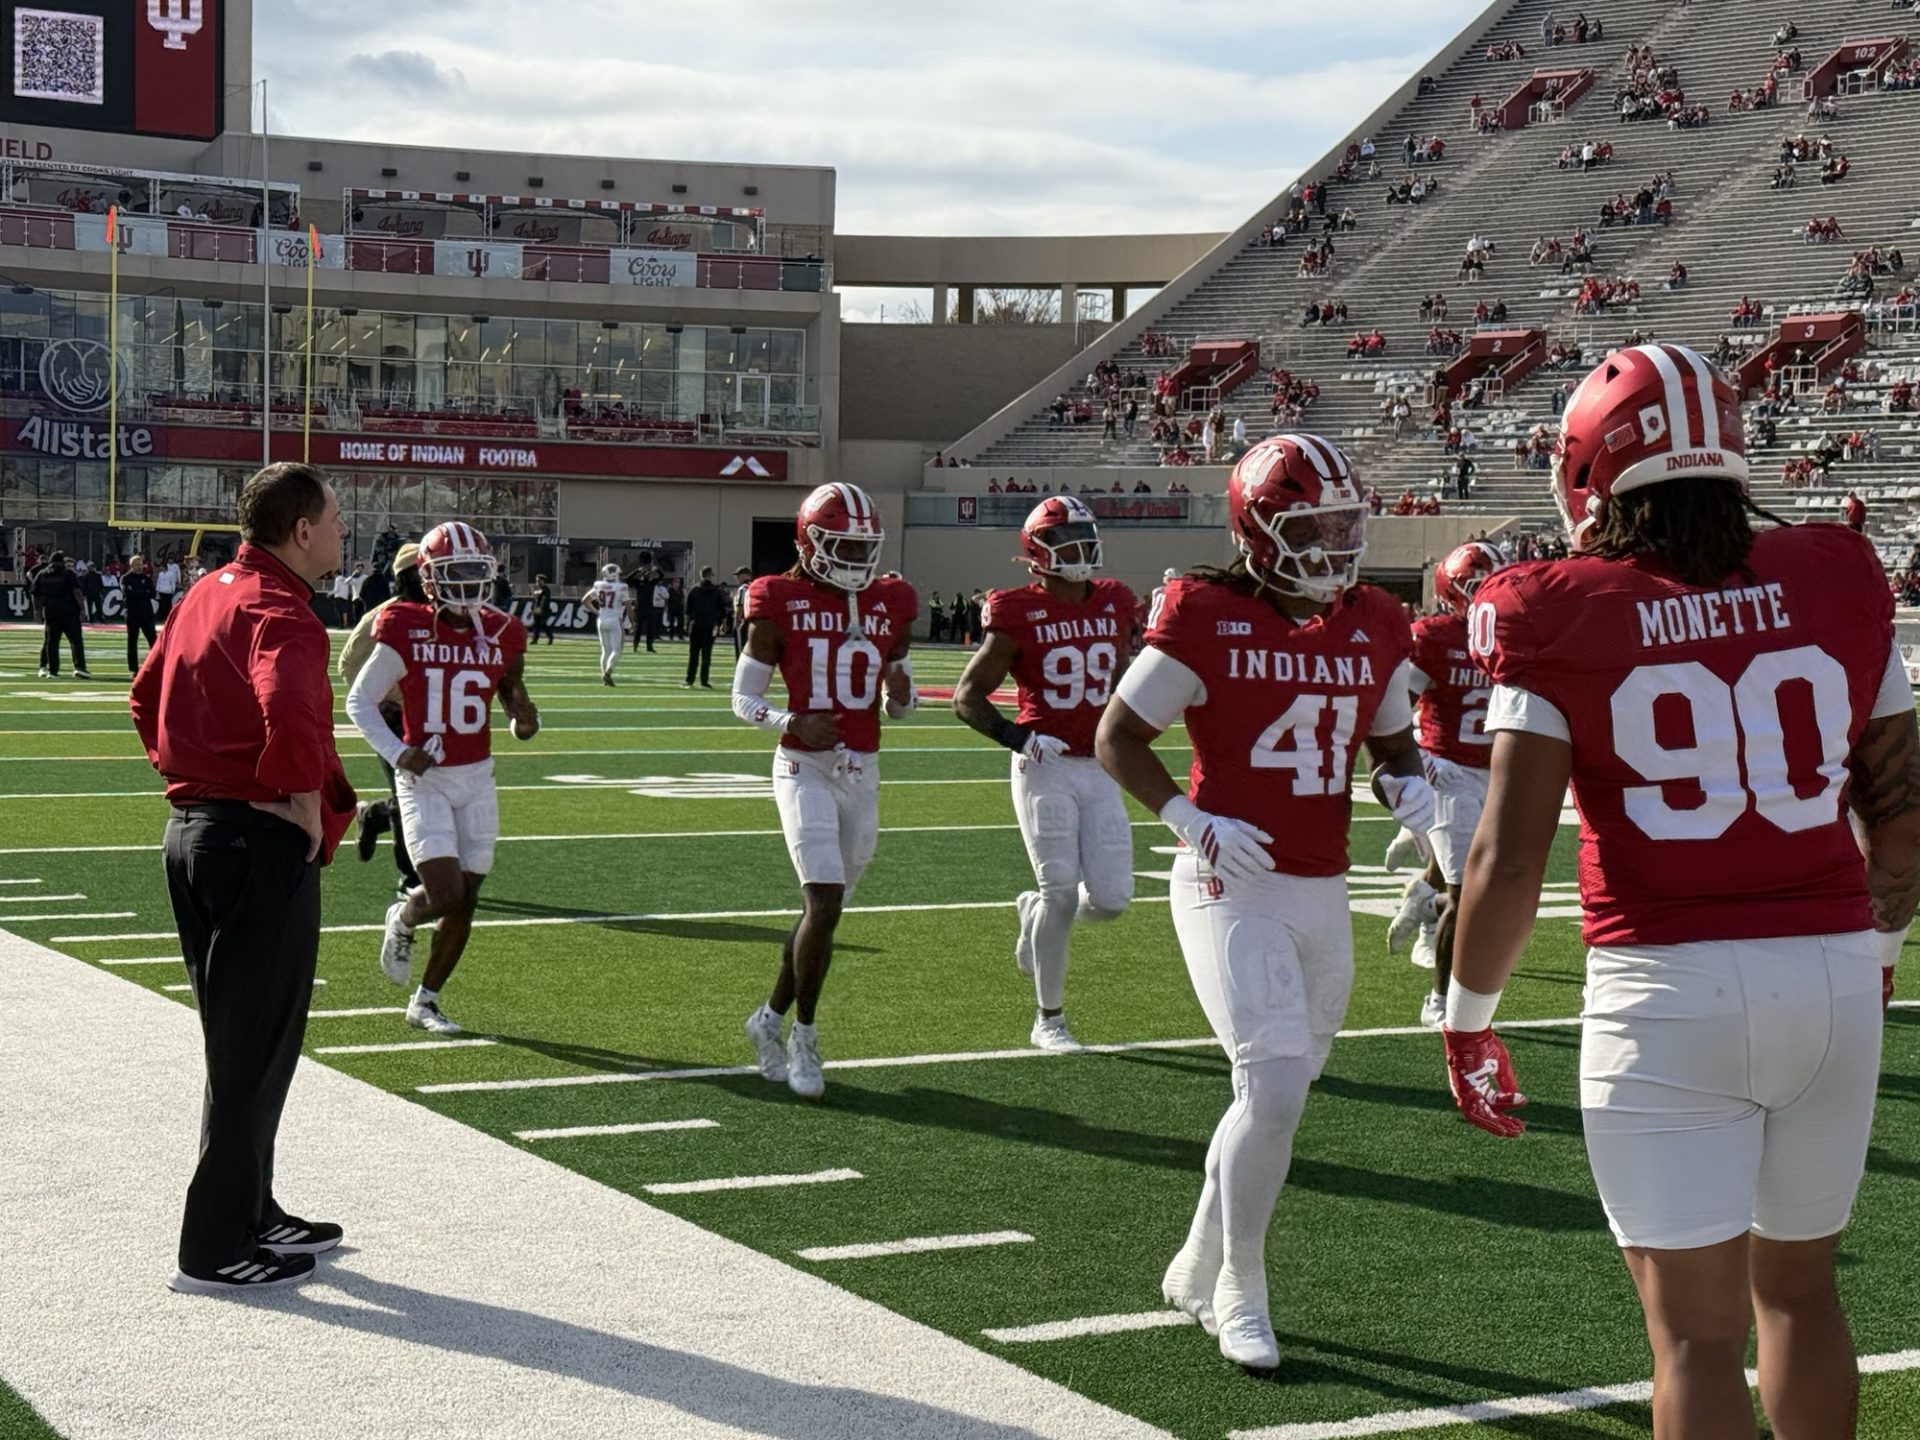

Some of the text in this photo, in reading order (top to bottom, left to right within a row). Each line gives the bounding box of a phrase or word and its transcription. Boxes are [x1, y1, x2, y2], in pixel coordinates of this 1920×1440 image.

[1854, 47, 1877, 59] 102
[377, 213, 424, 237] Indiana
[647, 226, 692, 248] Indiana
[275, 239, 324, 259] Coo
[628, 257, 677, 278] Coors
[633, 277, 672, 287] LIGHT
[1804, 324, 1815, 338] 3
[1211, 350, 1218, 363] 1
[1492, 340, 1502, 353] 2
[17, 415, 153, 459] Allstate
[340, 441, 537, 467] HOME OF INDIAN FOOTBA
[1666, 452, 1725, 471] INDIANA
[792, 611, 891, 636] INDINA
[1636, 582, 1791, 648] MONETTE
[1035, 618, 1118, 643] INDIANA
[412, 643, 503, 665] INDIANA
[807, 638, 882, 710] 10
[1042, 642, 1117, 710] 99
[1228, 648, 1375, 686] INDIANA
[424, 668, 491, 734] 16
[1250, 694, 1359, 796] 41
[1610, 645, 1852, 841] 90
